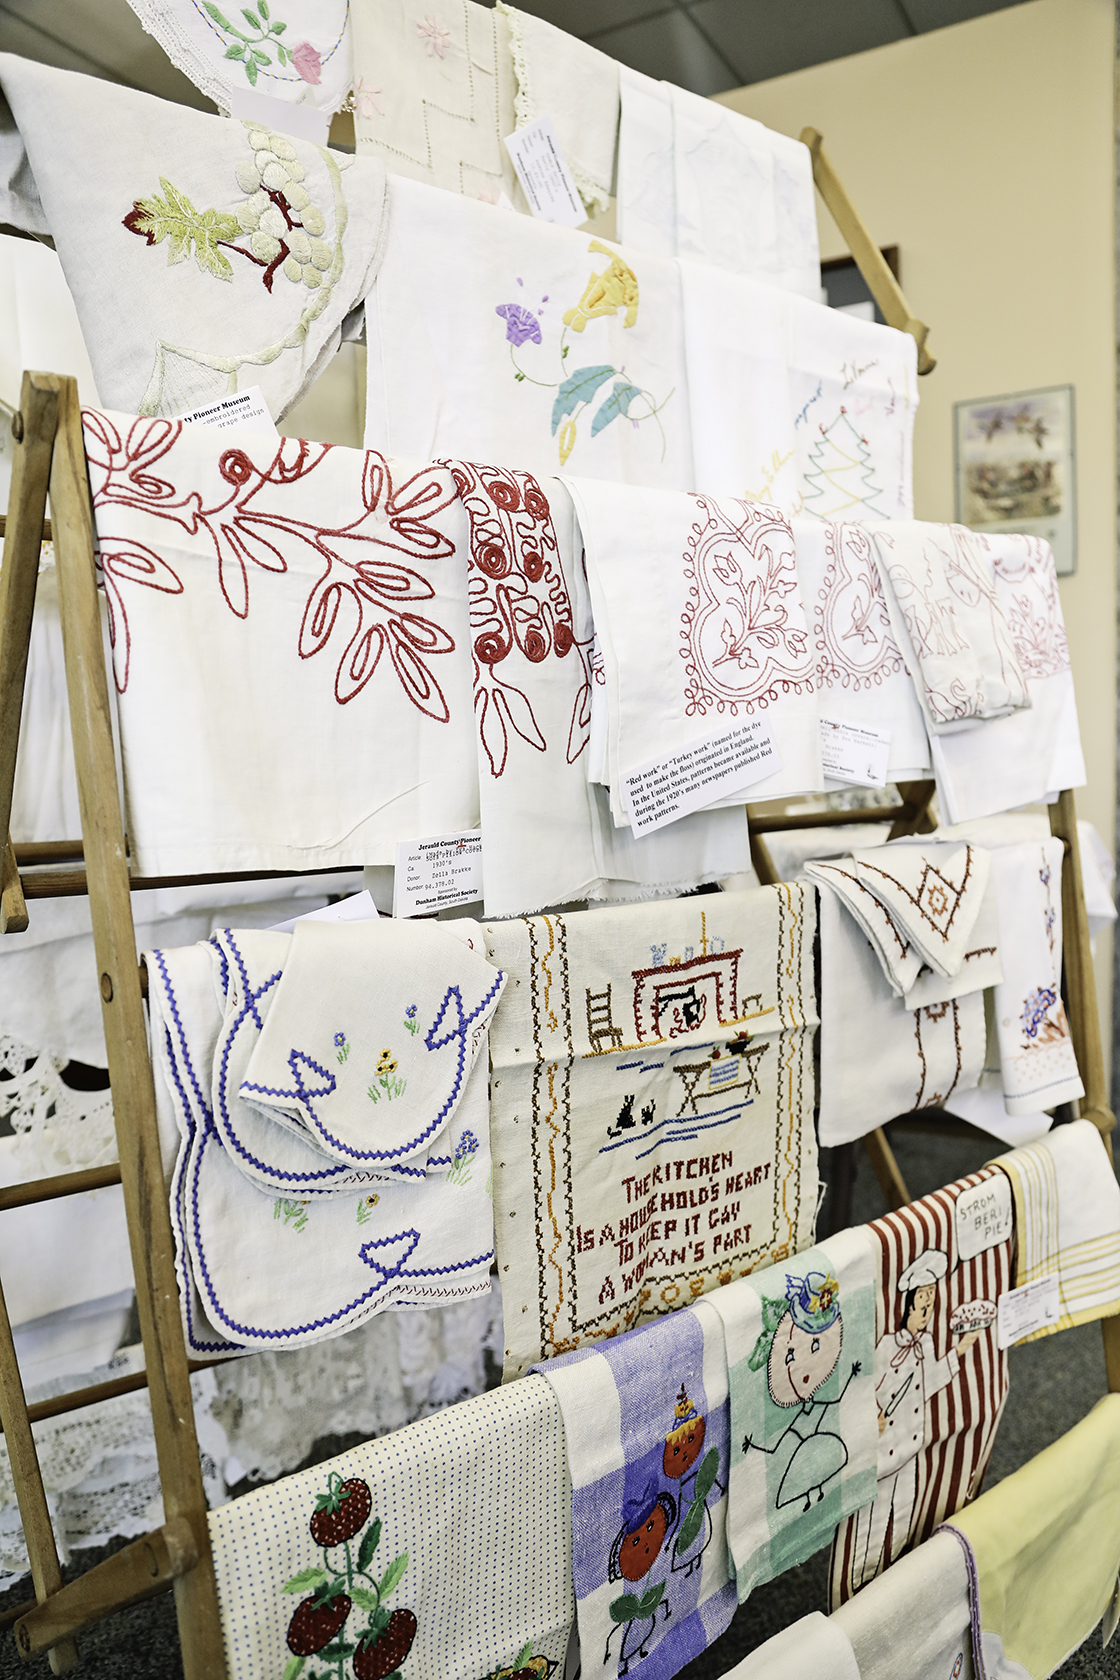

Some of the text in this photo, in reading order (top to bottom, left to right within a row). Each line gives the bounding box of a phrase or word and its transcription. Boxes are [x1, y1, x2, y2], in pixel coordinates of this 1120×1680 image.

[193, 405, 220, 420] Pioneer
[221, 395, 250, 409] Museum
[242, 408, 265, 420] design
[712, 733, 732, 748] (named
[752, 722, 761, 730] dye
[630, 785, 644, 796] used
[653, 775, 669, 785] make
[670, 770, 678, 778] the
[680, 761, 694, 773] floss)
[695, 748, 723, 766] originated
[730, 734, 754, 750] England.
[641, 794, 650, 803] the
[651, 784, 670, 797] United
[690, 765, 713, 781] patterns
[714, 755, 734, 768] became
[735, 743, 759, 758] available
[760, 737, 770, 747] and
[635, 748, 772, 817] during the 1920's many newspapers published Red
[638, 804, 680, 827] work patterns.
[418, 842, 439, 850] Jerauld
[437, 892, 460, 901] Historical
[652, 1150, 733, 1186] KITCHEN
[576, 1224, 595, 1254] IS
[599, 1223, 615, 1246] A
[725, 1162, 771, 1196] HEART
[960, 1194, 996, 1220] STROM
[975, 1205, 1001, 1230] BERI
[614, 1200, 741, 1267] TO KEEP IT GAY
[598, 1224, 752, 1305] A WOMAN'S PART
